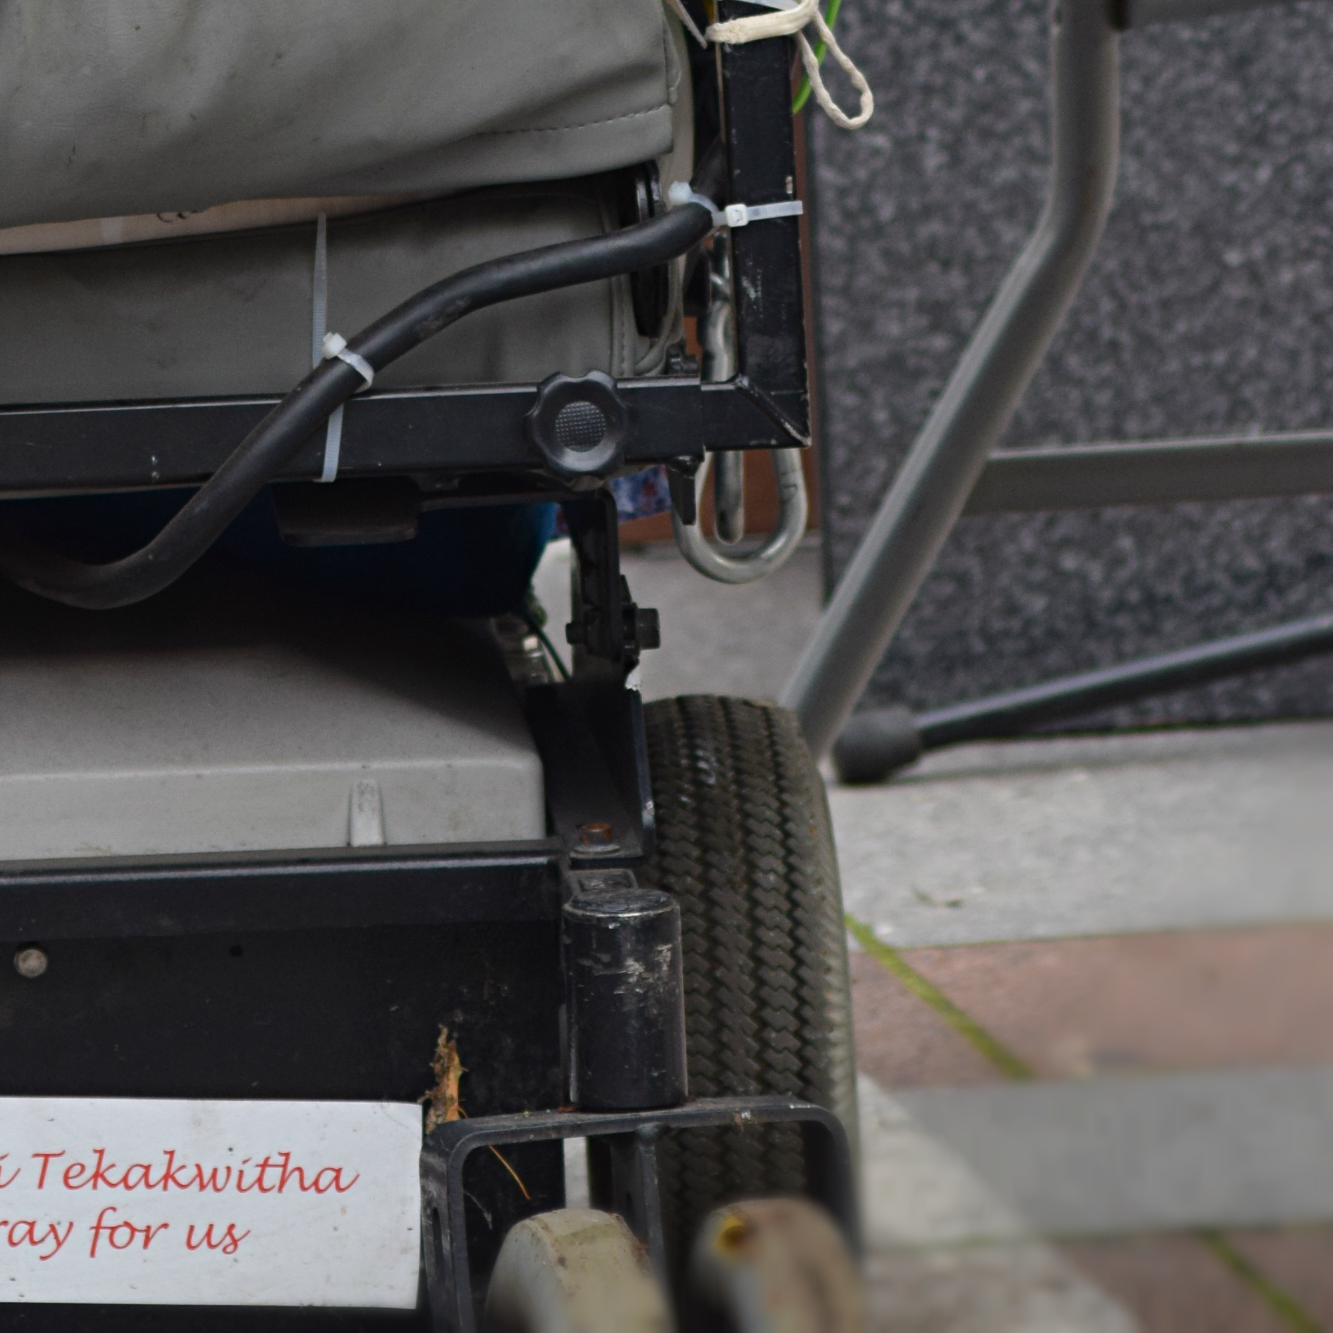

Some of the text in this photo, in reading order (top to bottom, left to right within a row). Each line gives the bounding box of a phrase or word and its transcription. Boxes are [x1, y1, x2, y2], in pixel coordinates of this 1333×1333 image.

[31, 1149, 360, 1194] Tekakwitha
[88, 1206, 169, 1258] for
[185, 1218, 251, 1255] us
